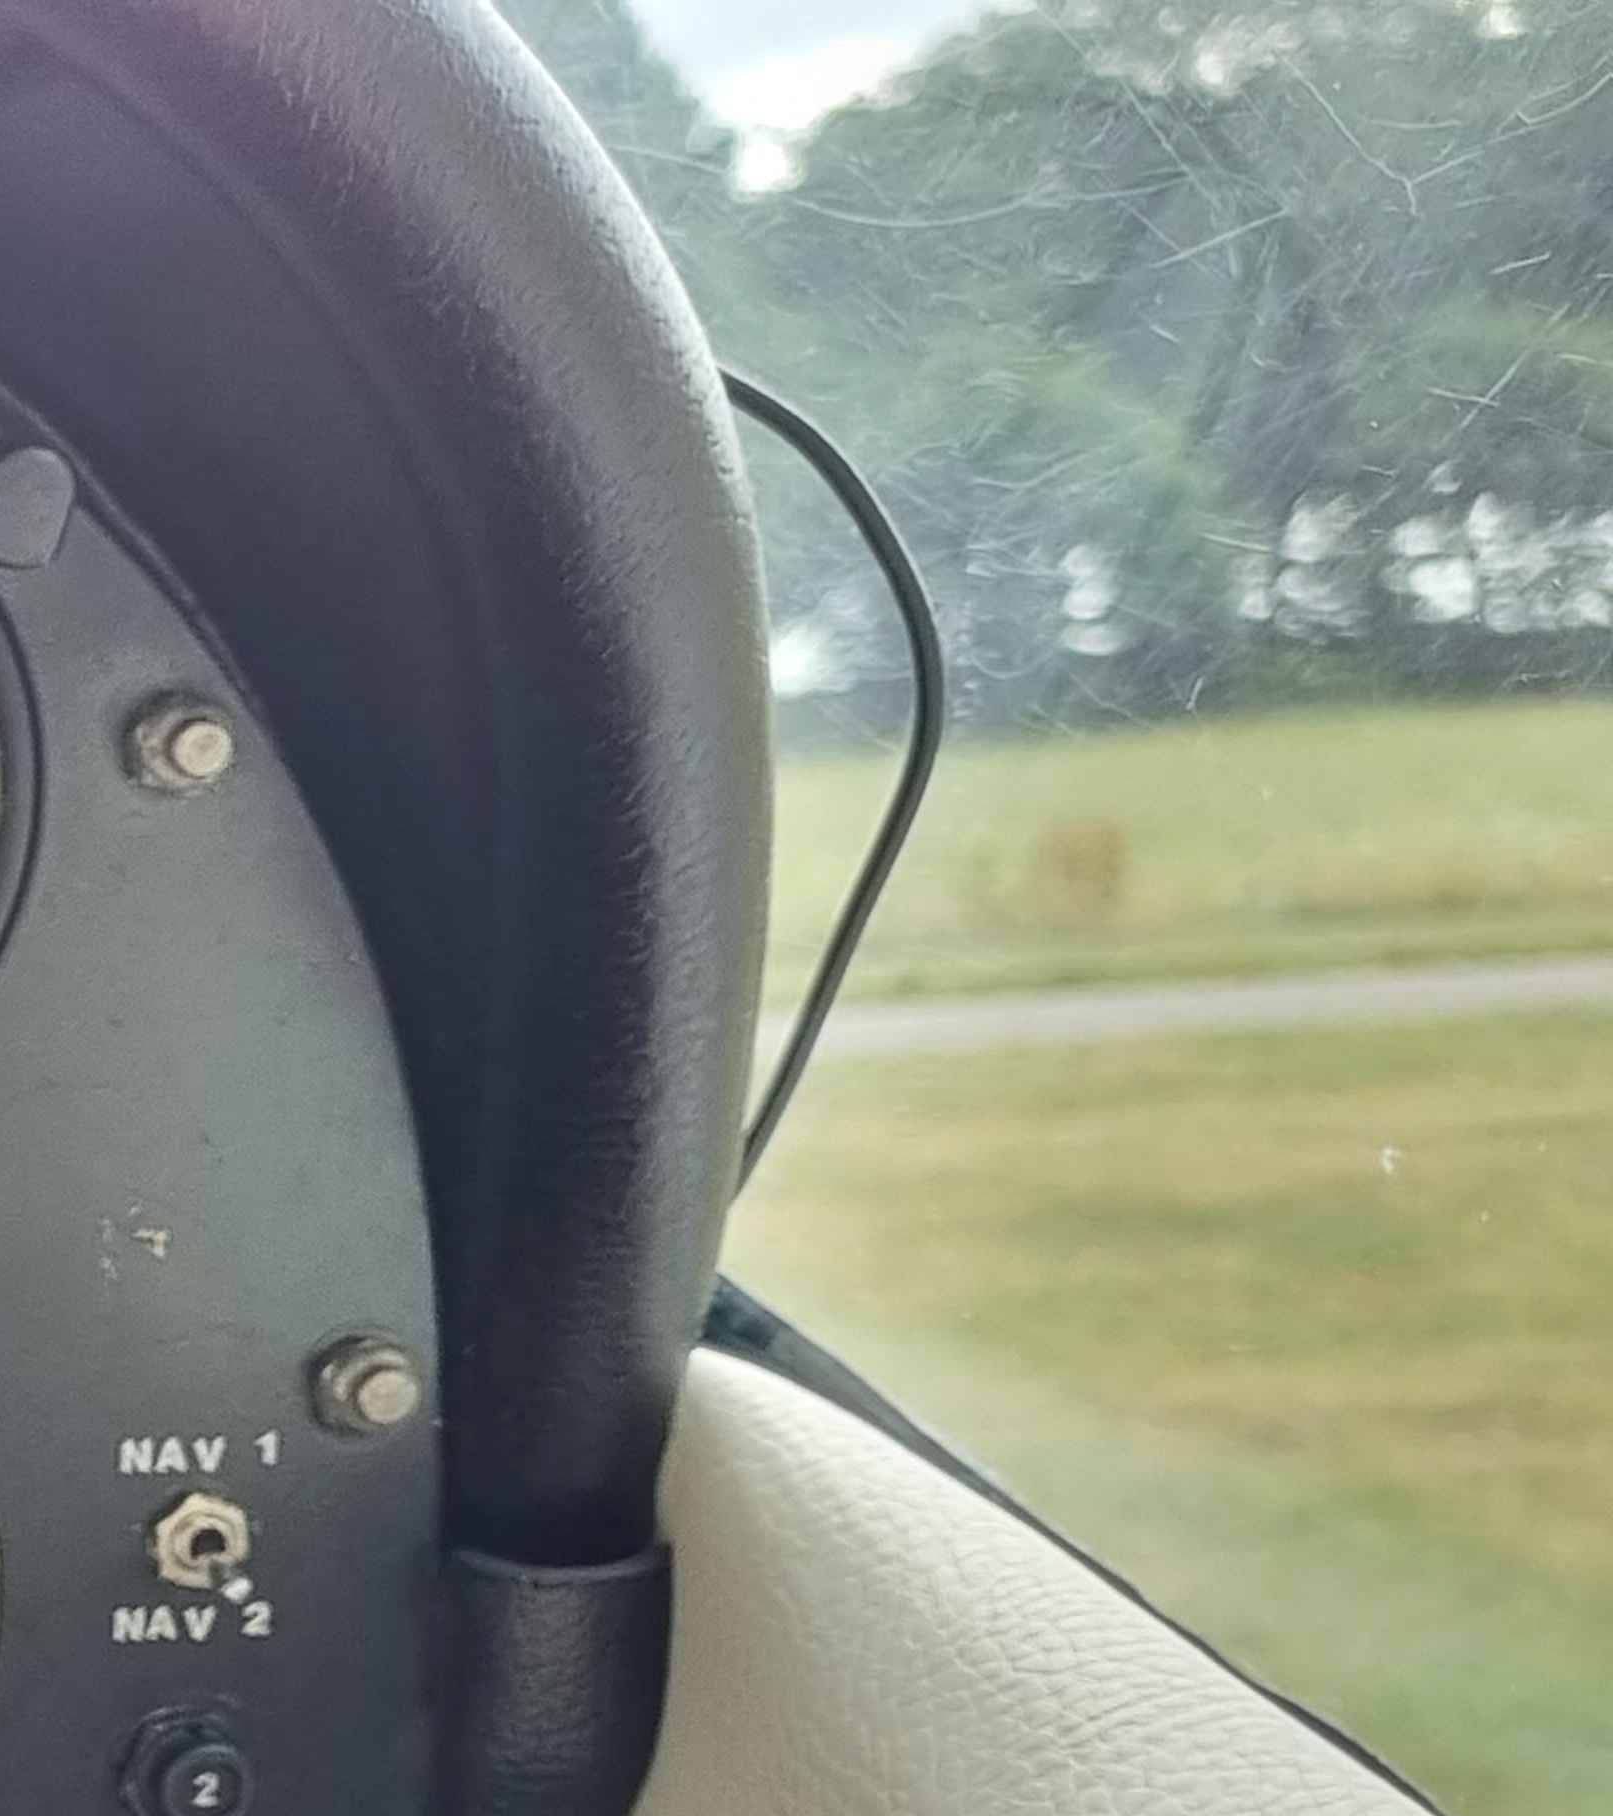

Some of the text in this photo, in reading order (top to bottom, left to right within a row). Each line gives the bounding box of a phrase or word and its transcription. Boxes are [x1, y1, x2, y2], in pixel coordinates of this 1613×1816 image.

[119, 1431, 281, 1475] NAV 1
[111, 1602, 273, 1643] NAV 2
